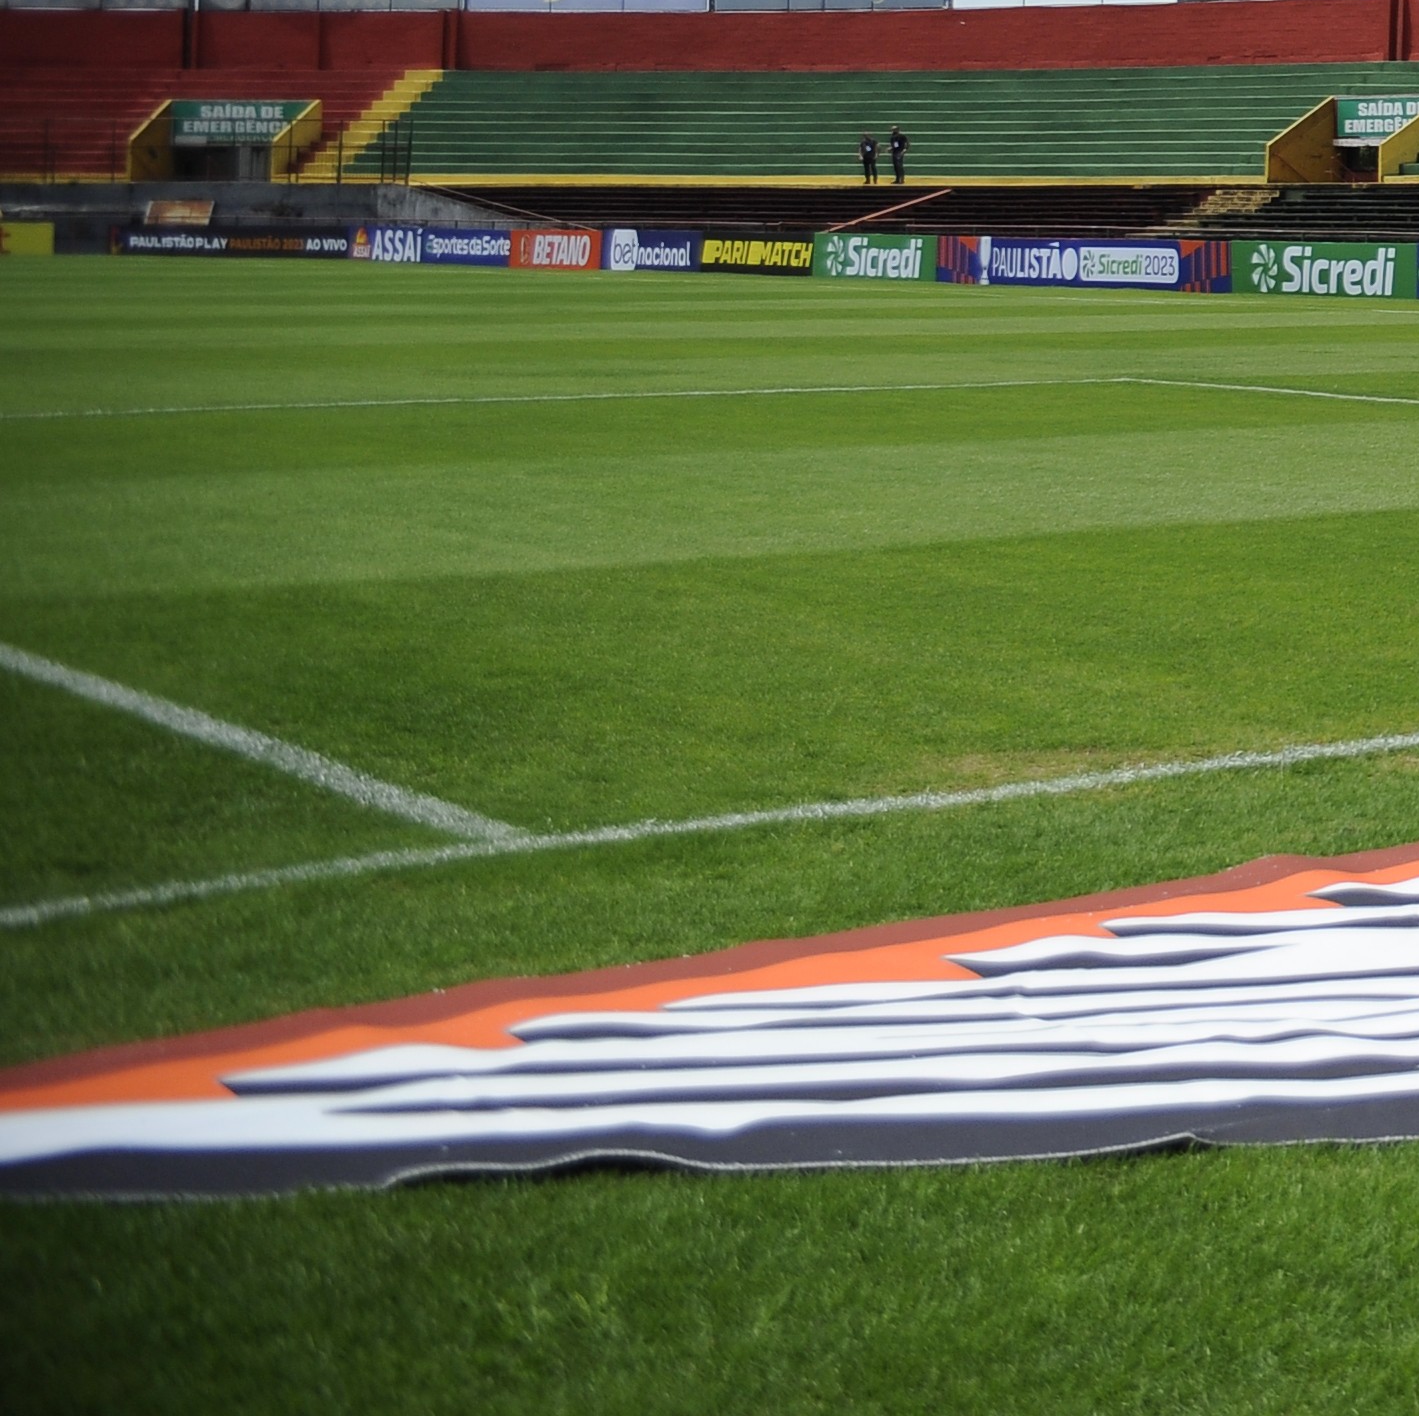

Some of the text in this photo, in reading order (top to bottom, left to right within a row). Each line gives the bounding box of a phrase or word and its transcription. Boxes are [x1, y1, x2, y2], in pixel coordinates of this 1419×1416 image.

[201, 104, 284, 119] SAÍDA DE
[1357, 100, 1403, 116] SAÍDA
[1344, 117, 1411, 133] EMERGÊ
[306, 238, 321, 251] AO
[322, 238, 347, 251] VIVO
[532, 235, 590, 266] BETANO
[846, 237, 923, 278] Sicredi
[992, 242, 1078, 280] PAULISTÃO
[1099, 254, 1175, 276] Sicredi 2023
[1282, 245, 1395, 296] Sicredi
